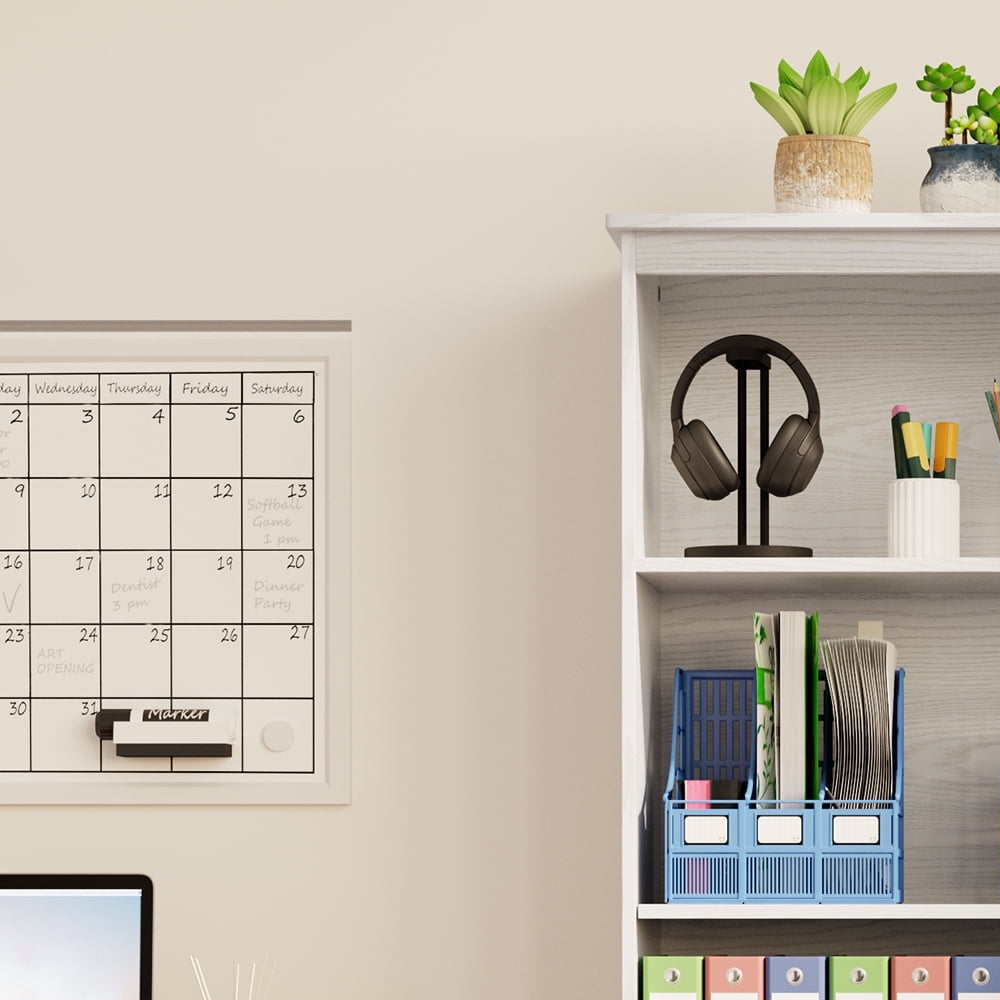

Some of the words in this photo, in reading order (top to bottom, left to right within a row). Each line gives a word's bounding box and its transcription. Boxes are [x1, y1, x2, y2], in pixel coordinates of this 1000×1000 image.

[35, 382, 97, 397] Wednesday
[107, 382, 161, 397] Thursday
[183, 382, 228, 397] Friday
[252, 382, 303, 397] Saturday
[10, 409, 23, 424] 2
[82, 410, 93, 423] 3
[152, 409, 165, 424] 4
[225, 407, 239, 421] 5
[293, 409, 305, 423] 6
[15, 484, 24, 497] 9
[82, 484, 96, 498] 10
[154, 484, 171, 498] 11
[213, 484, 233, 498] 12
[288, 484, 307, 498] 13
[247, 499, 303, 513] Softball
[253, 515, 292, 527] Game
[277, 536, 301, 547] pm
[4, 555, 23, 569] 16
[76, 556, 93, 570] 17
[146, 556, 164, 571] 18
[217, 556, 233, 570] 19
[287, 554, 305, 569] 20
[112, 578, 160, 594] Dentist
[254, 580, 304, 592] Dinner
[112, 601, 121, 611] 3
[128, 600, 150, 612] pm
[255, 597, 291, 612] Party
[5, 628, 24, 643] 23
[80, 628, 98, 643] 24
[150, 628, 169, 643] 25
[221, 628, 238, 642] 26
[290, 625, 310, 640] 27
[37, 649, 64, 659] ART
[37, 663, 94, 674] OPENING
[10, 701, 27, 716] 30
[81, 701, 98, 716] 31
[148, 709, 208, 720] Marker
